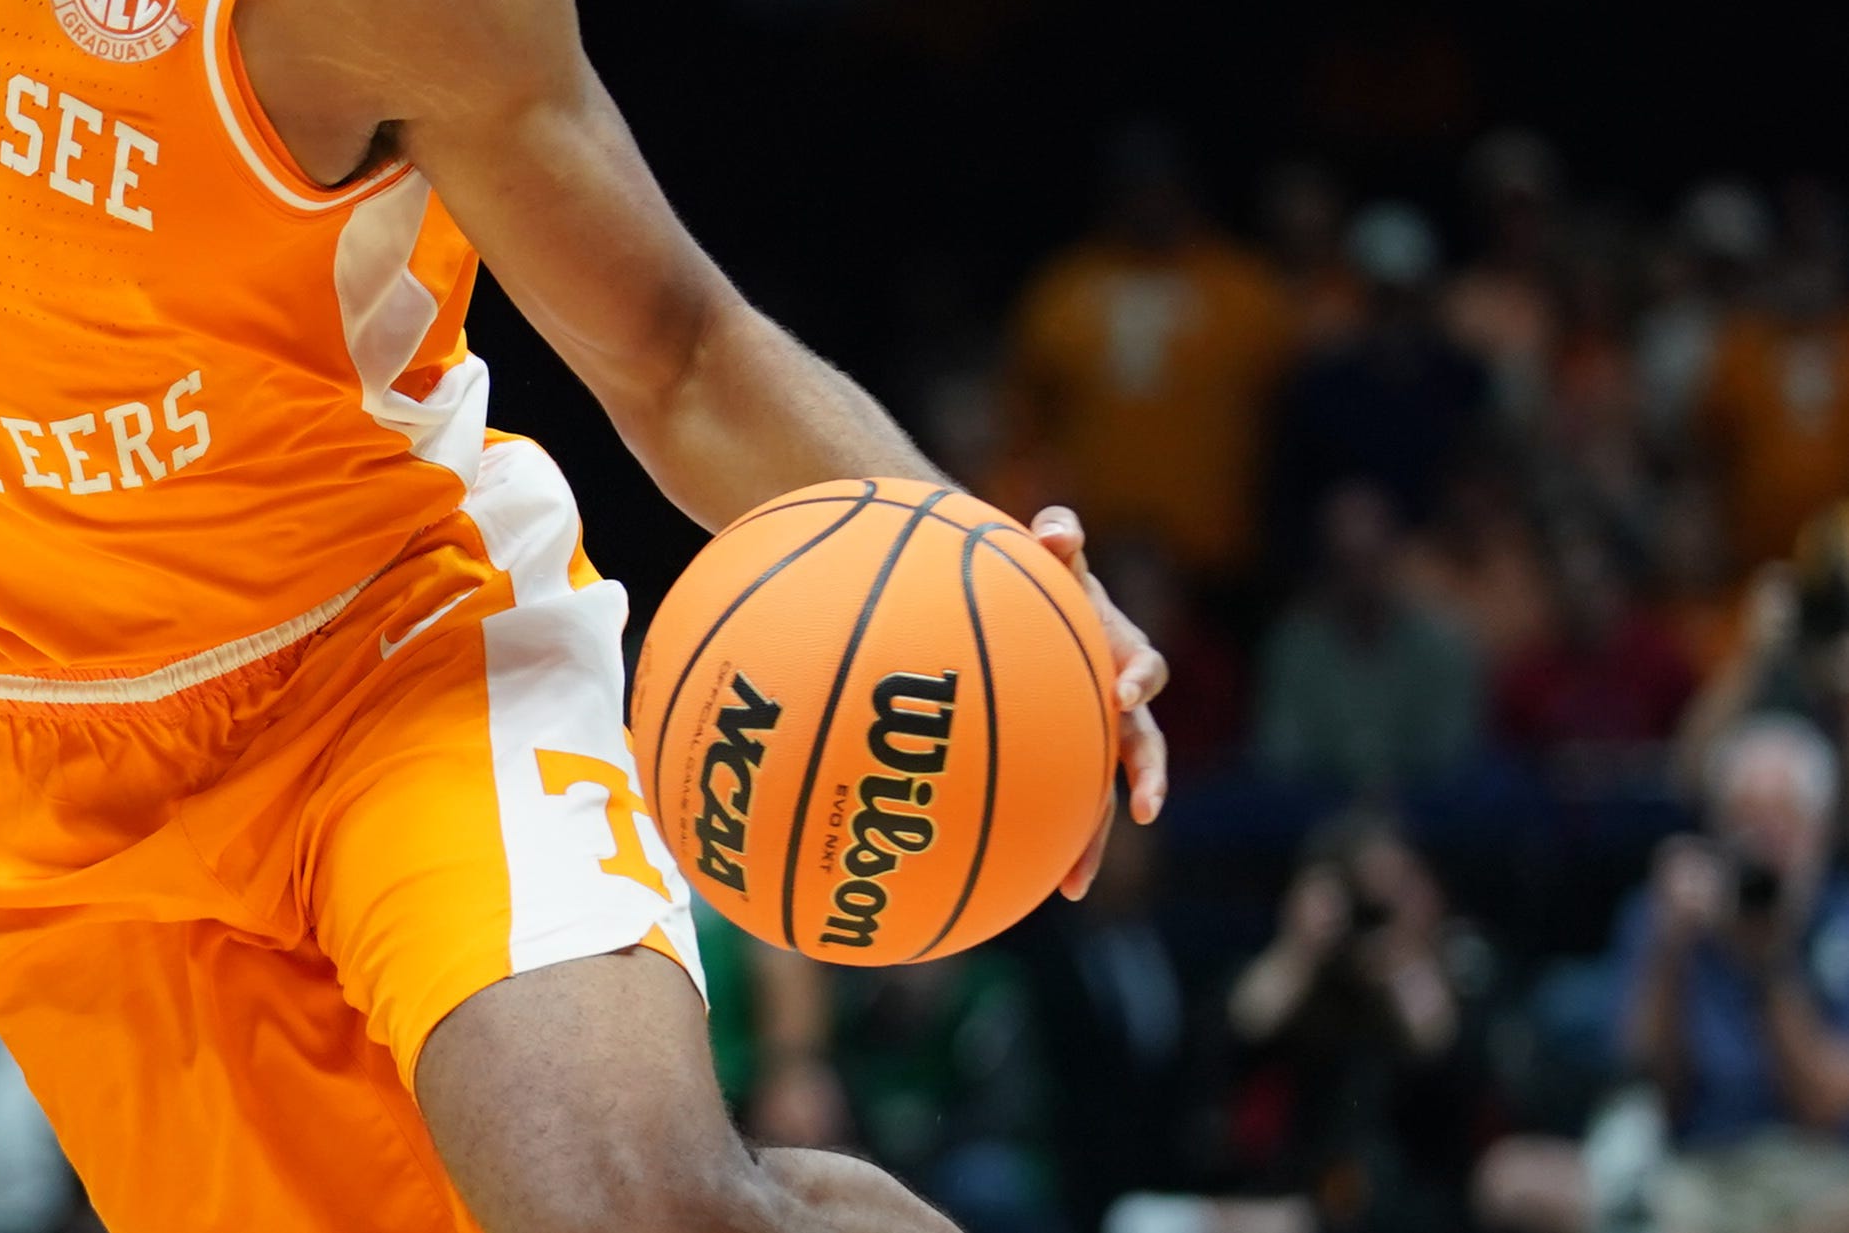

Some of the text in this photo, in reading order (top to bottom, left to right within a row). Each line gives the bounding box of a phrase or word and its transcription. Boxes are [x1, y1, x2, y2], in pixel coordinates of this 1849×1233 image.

[63, 11, 167, 62] GRADUATE
[694, 670, 783, 894] NCAA
[818, 669, 958, 948] Wilson
[820, 784, 848, 874] EVO NXT
